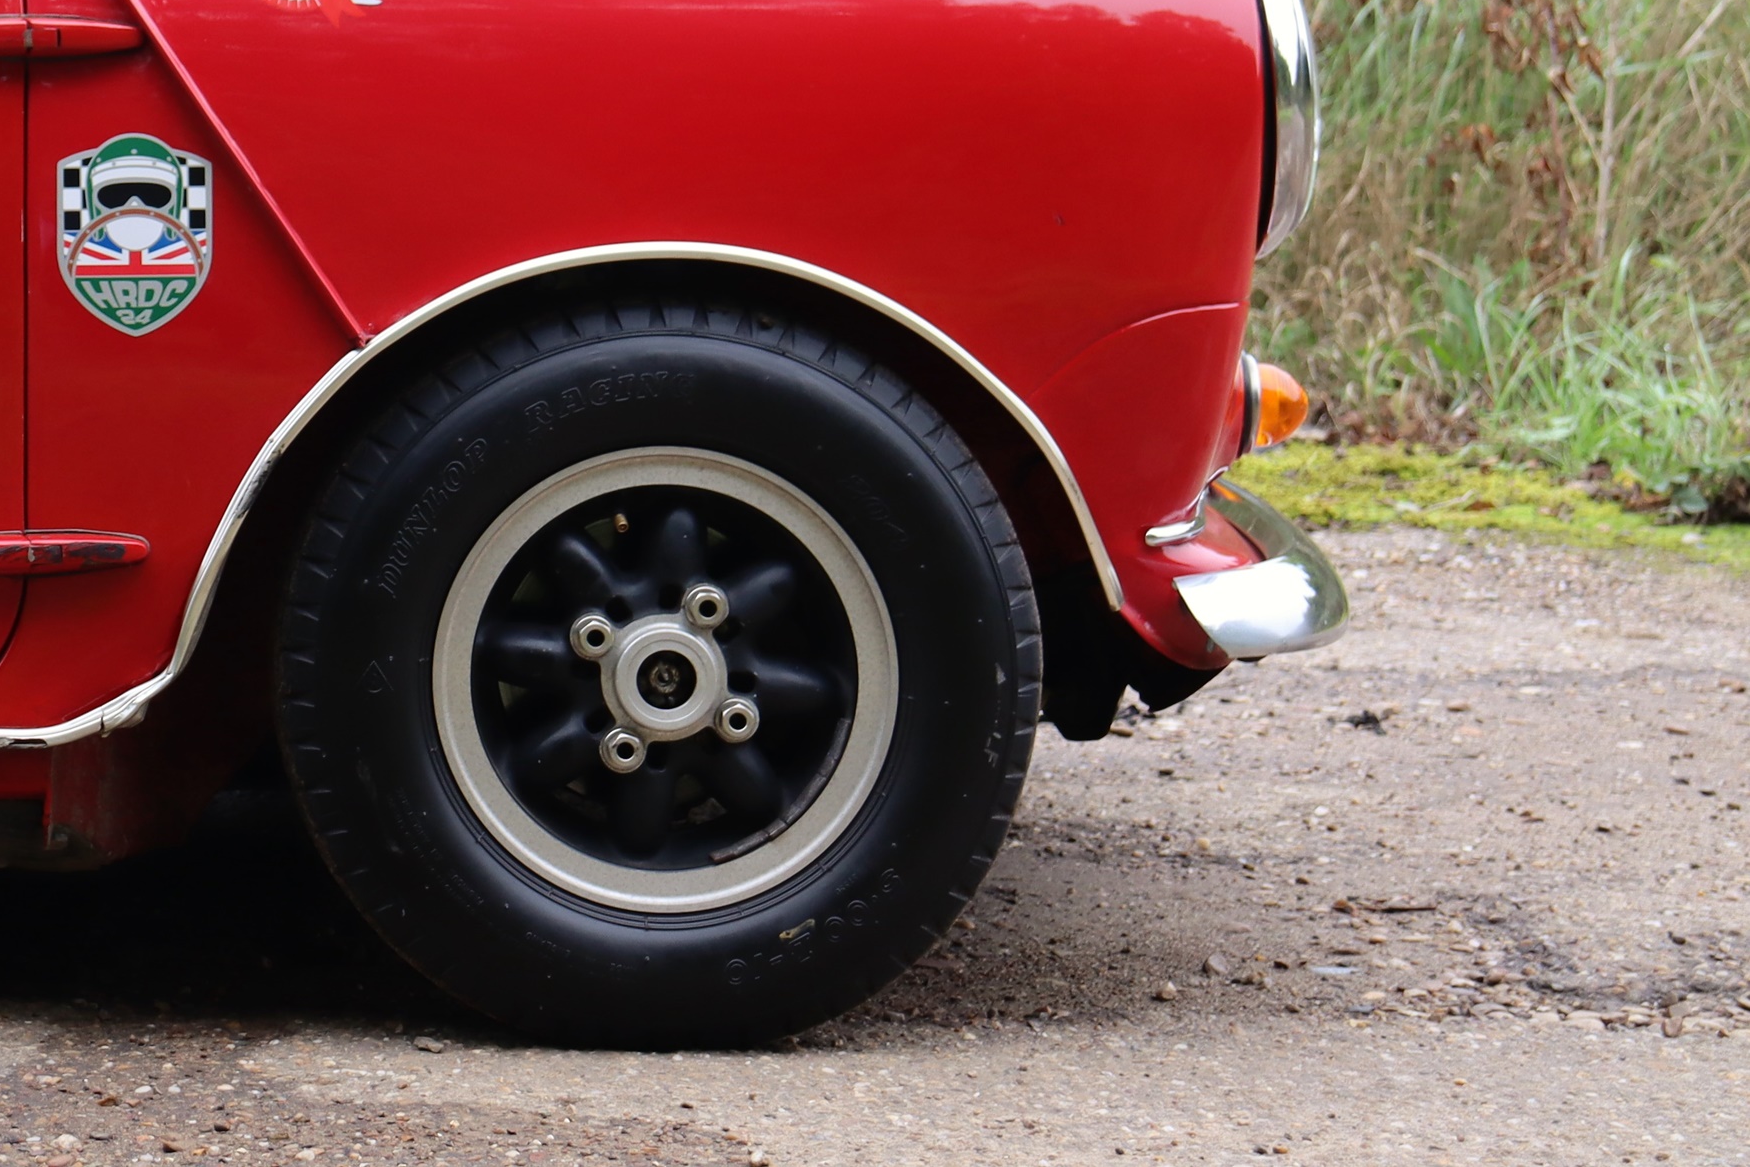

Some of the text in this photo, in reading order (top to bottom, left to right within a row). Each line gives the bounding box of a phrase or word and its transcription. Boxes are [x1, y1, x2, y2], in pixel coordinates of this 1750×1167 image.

[80, 279, 189, 309] HRDC
[116, 308, 154, 325] 24
[377, 370, 697, 600] DUNLOP RACING
